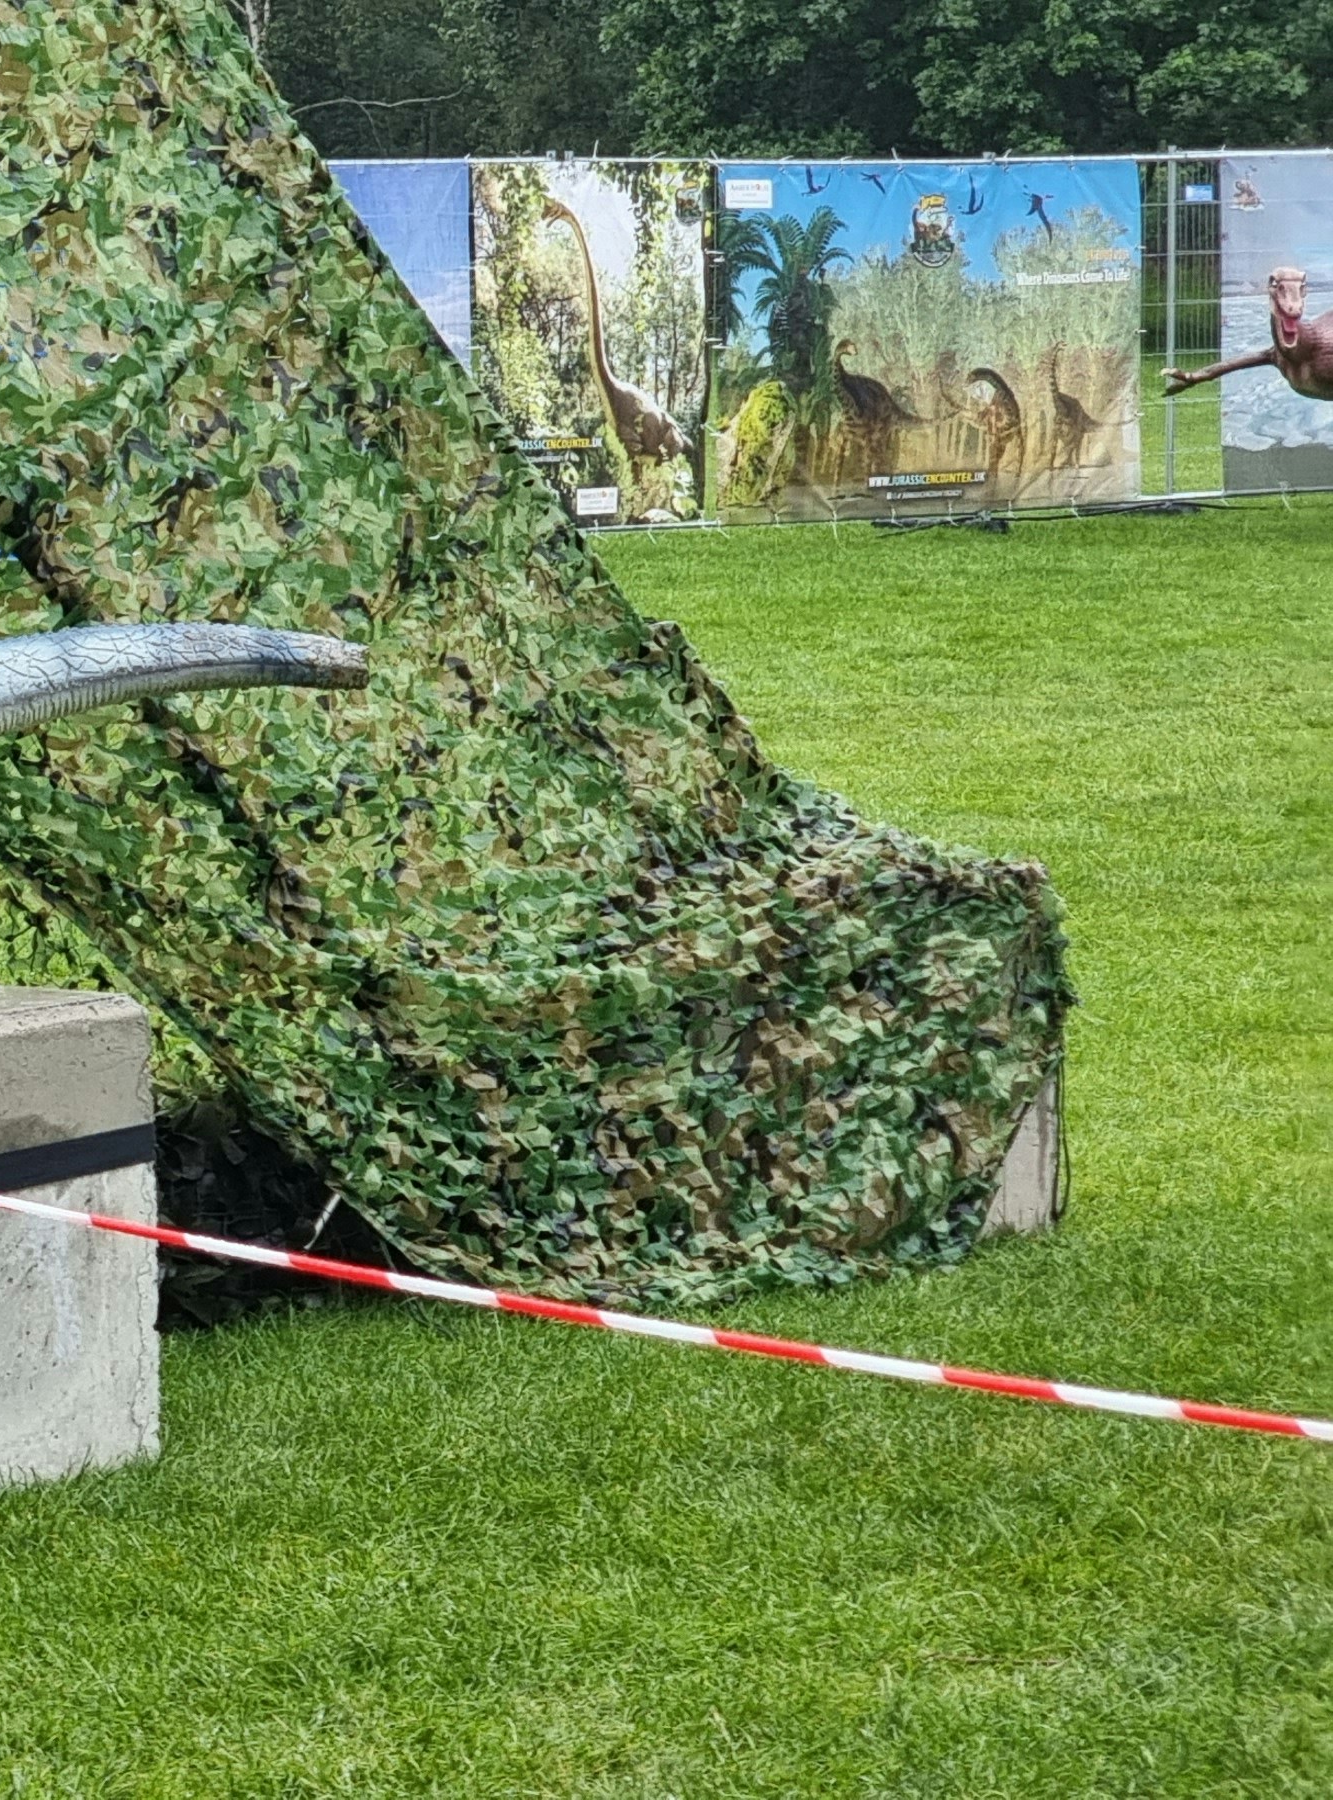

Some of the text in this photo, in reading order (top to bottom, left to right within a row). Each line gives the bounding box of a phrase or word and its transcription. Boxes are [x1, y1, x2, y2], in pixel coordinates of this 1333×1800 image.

[1016, 272, 1042, 285] Where
[1043, 271, 1080, 284] Dinosaurs
[1081, 269, 1103, 283] Come
[1104, 268, 1113, 282] To
[868, 471, 986, 488] WWW.JURASSICENCOUNTER.UK
